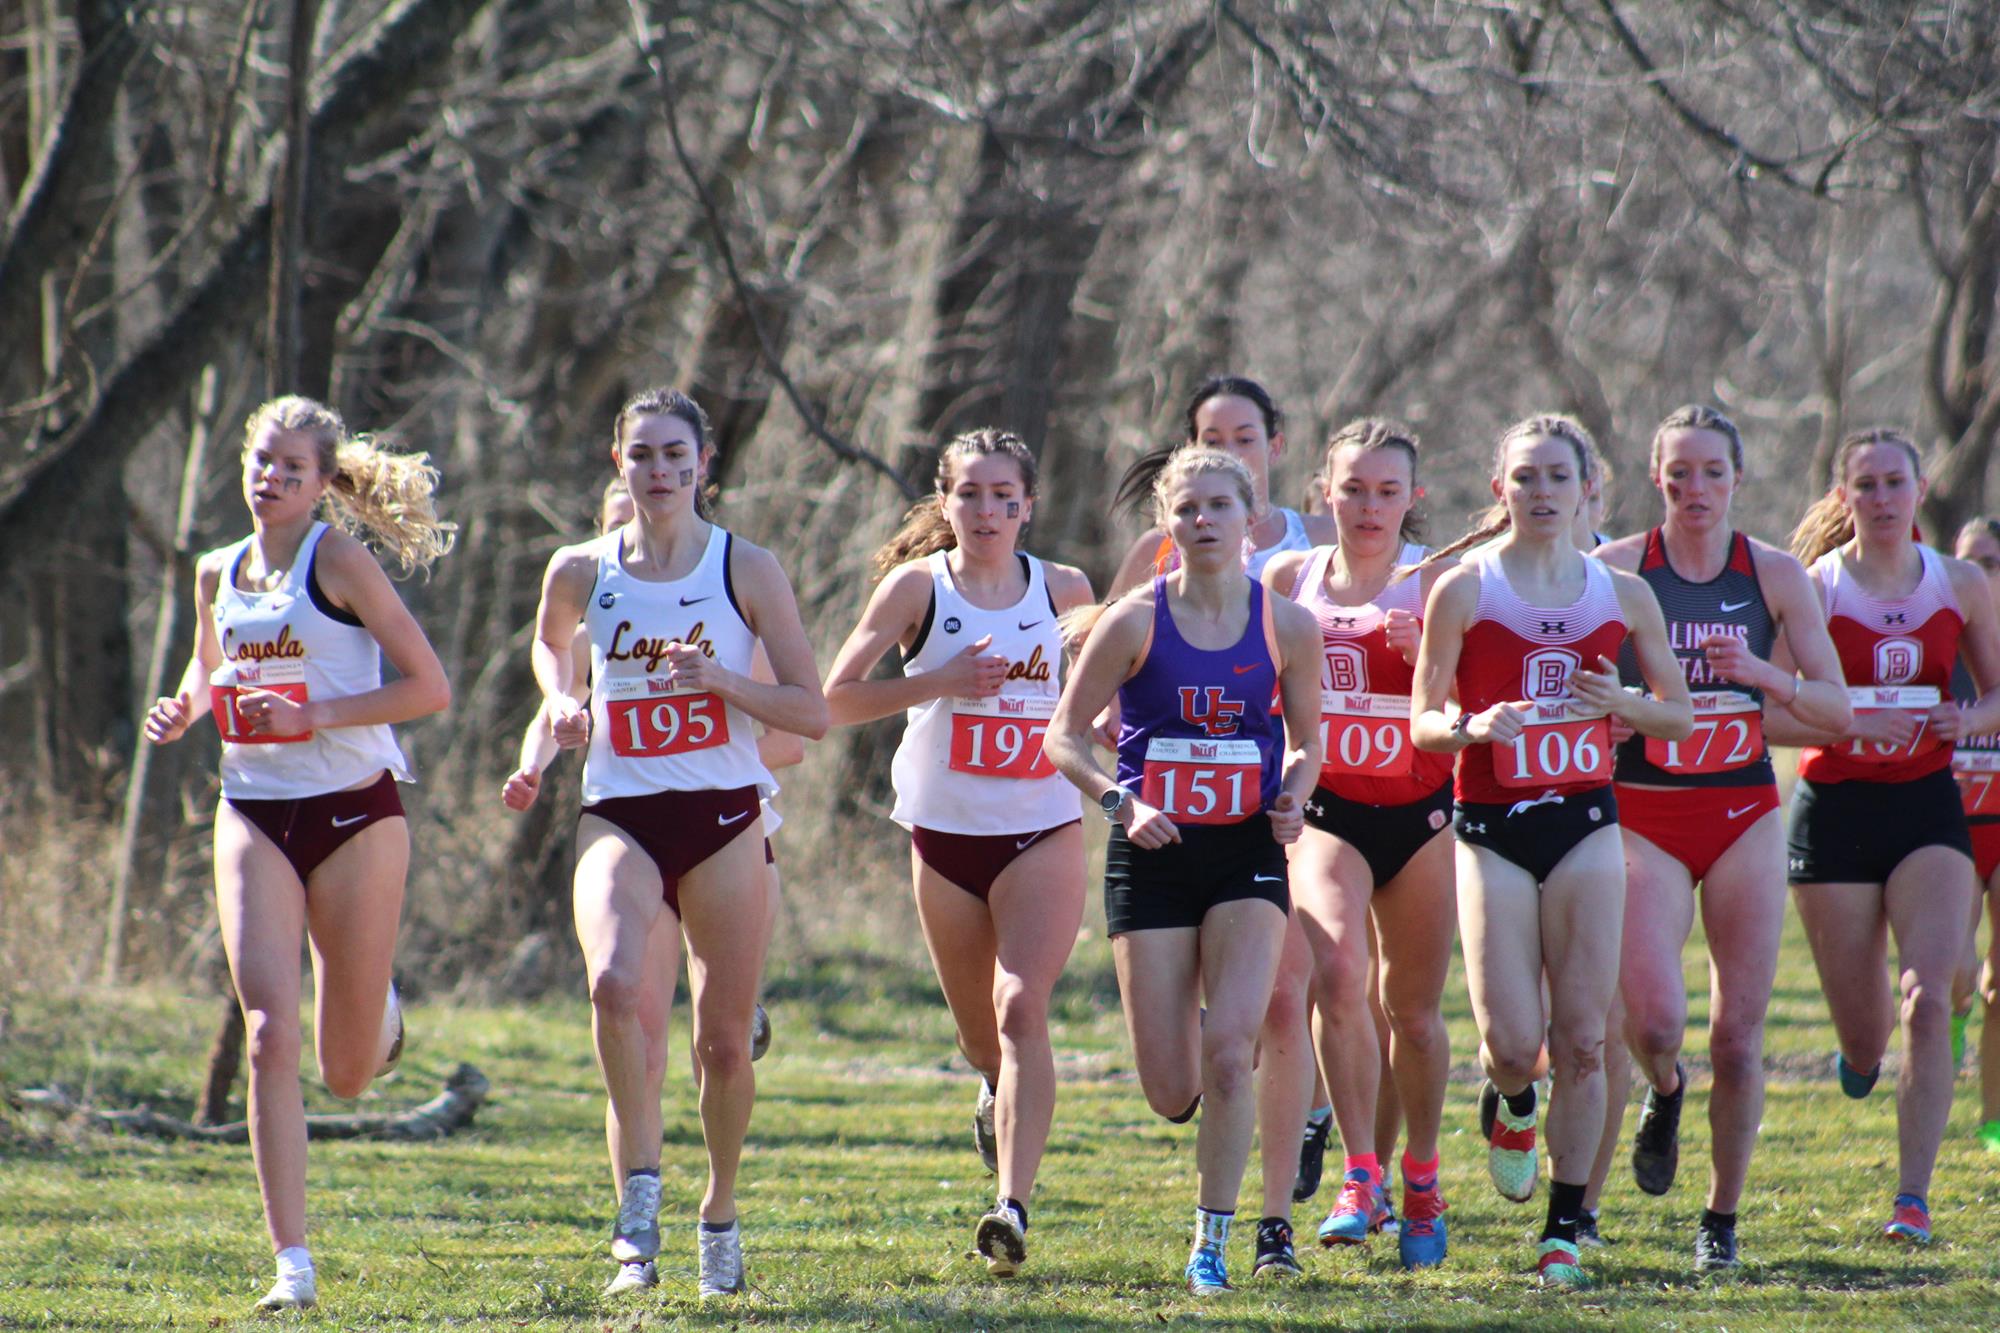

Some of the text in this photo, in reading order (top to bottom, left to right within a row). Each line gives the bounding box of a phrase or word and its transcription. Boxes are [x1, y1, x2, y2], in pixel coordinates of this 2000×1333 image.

[1005, 644, 1050, 682] ola
[623, 699, 714, 750] 195
[967, 723, 1048, 771] 197
[1320, 720, 1402, 768] 109
[1512, 725, 1600, 779] 106
[1158, 768, 1245, 816] 151
